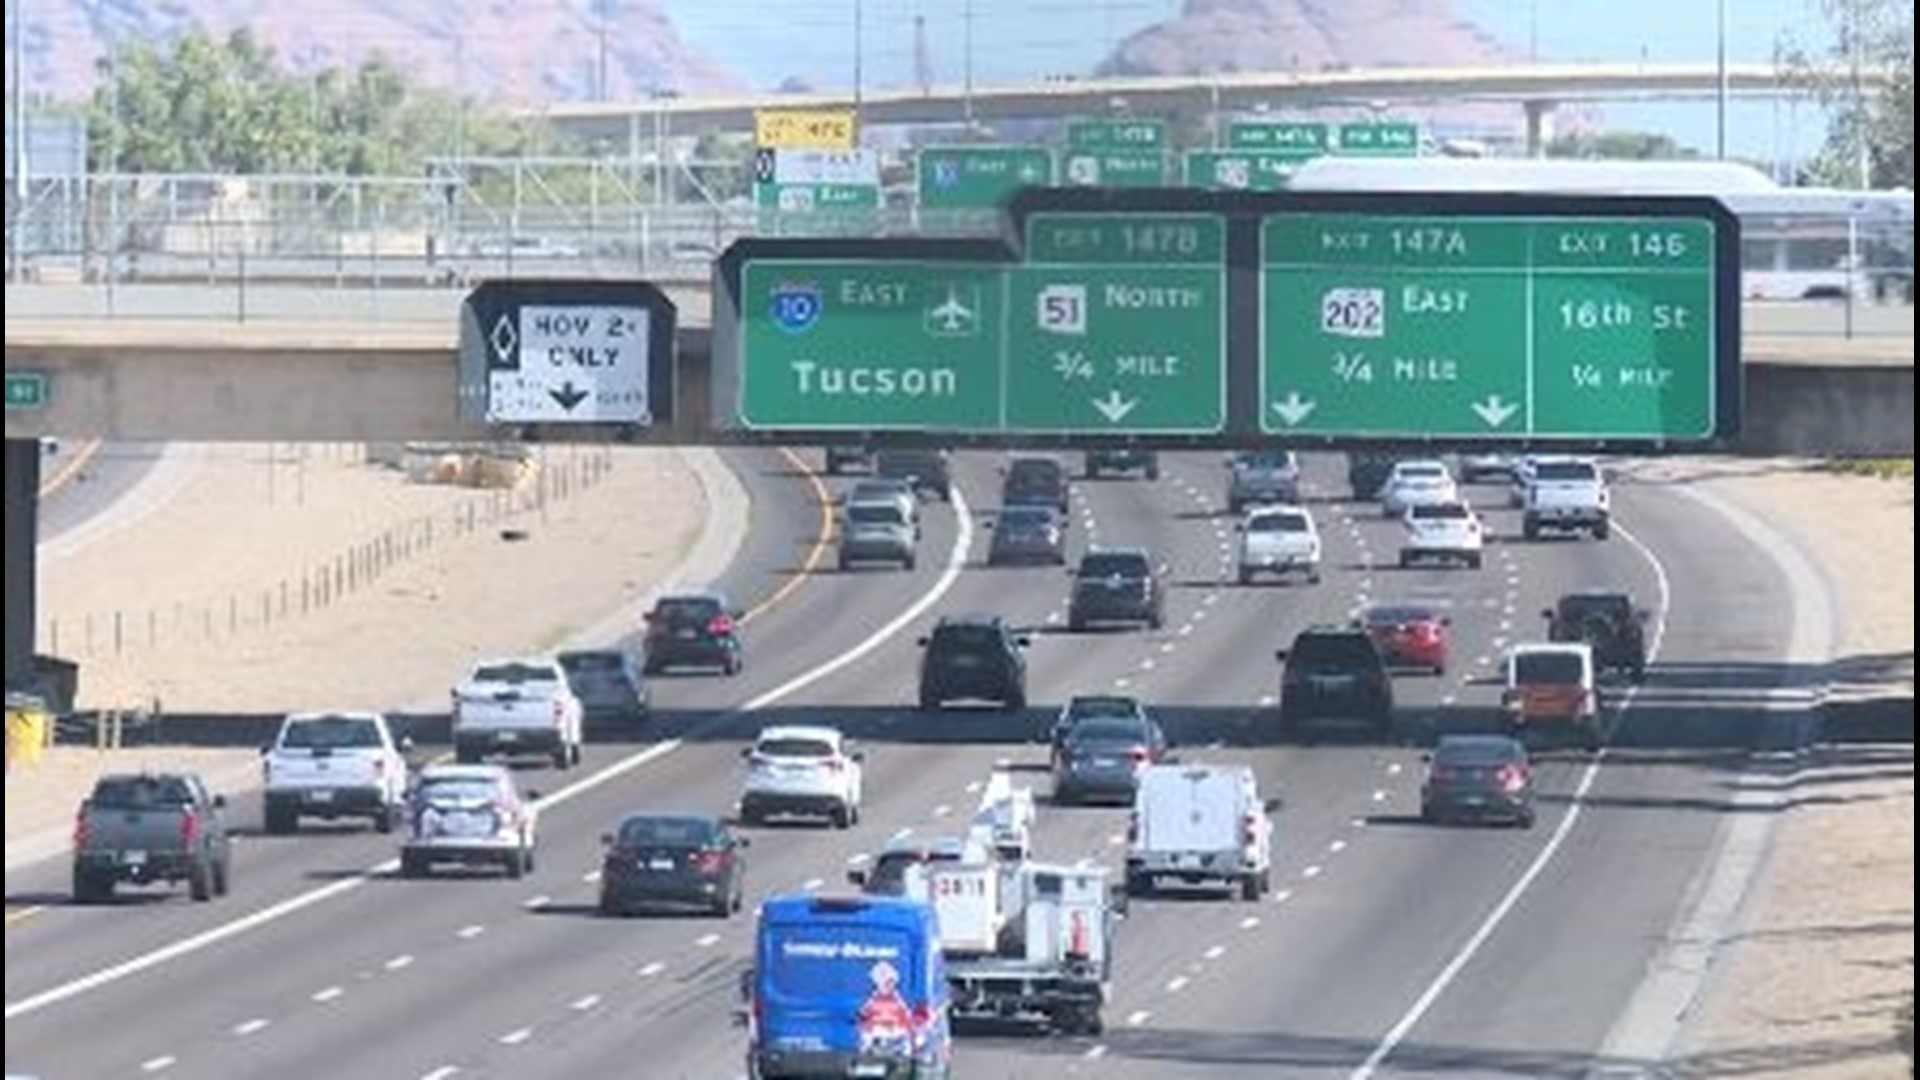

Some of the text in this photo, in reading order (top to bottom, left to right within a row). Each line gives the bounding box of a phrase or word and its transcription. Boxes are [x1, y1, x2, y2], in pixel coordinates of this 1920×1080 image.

[1119, 226, 1198, 253] 147B
[1389, 230, 1467, 254] 147A
[1628, 232, 1686, 256] 146
[779, 299, 809, 322] 10
[1044, 298, 1081, 324] 51
[1325, 301, 1381, 328] 202
[1560, 301, 1689, 329] 16th St
[534, 316, 590, 337] HOV
[548, 347, 620, 367] ONLY
[1115, 355, 1180, 377] MILE
[1394, 357, 1458, 379] MILE
[791, 361, 957, 395] Tucson
[1619, 367, 1673, 385] MILE
